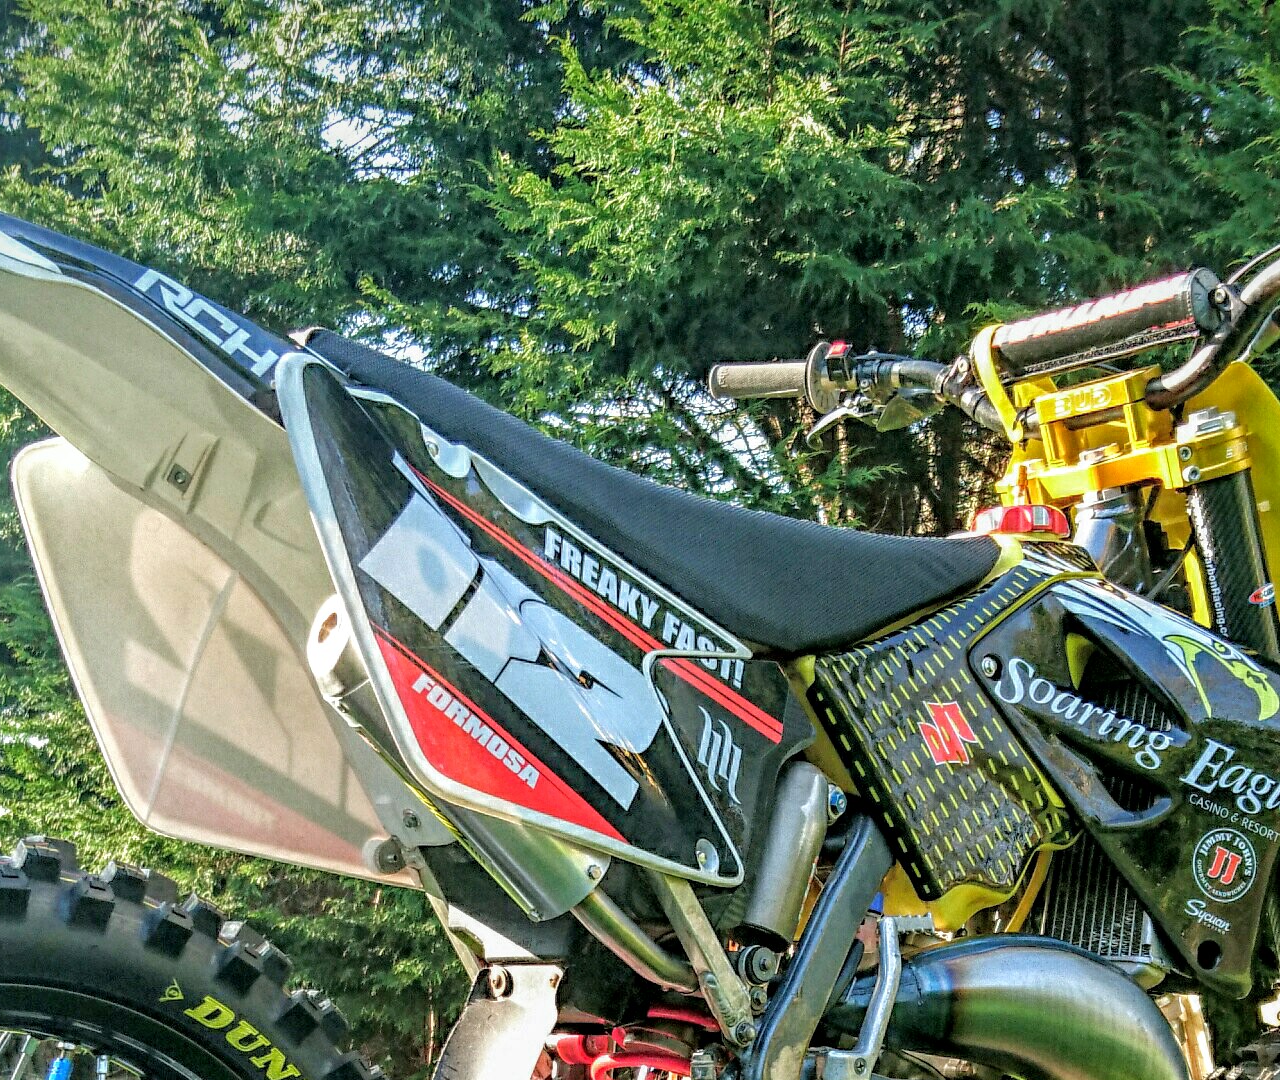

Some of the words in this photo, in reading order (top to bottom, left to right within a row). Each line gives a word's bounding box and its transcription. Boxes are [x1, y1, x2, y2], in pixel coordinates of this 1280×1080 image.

[133, 268, 280, 378] RCH
[543, 526, 660, 629] FREAKY
[662, 610, 744, 689] FAST!
[411, 672, 541, 790] FORMOSA
[993, 657, 1176, 770] Soaring
[1189, 793, 1230, 819] CASINO
[1230, 812, 1239, 823] &
[1241, 817, 1280, 843] RESORT
[1198, 832, 1234, 857] JIMMY
[1233, 836, 1253, 878] JOHN'S
[1206, 845, 1243, 886] JJ
[1183, 898, 1232, 932] Sycuan
